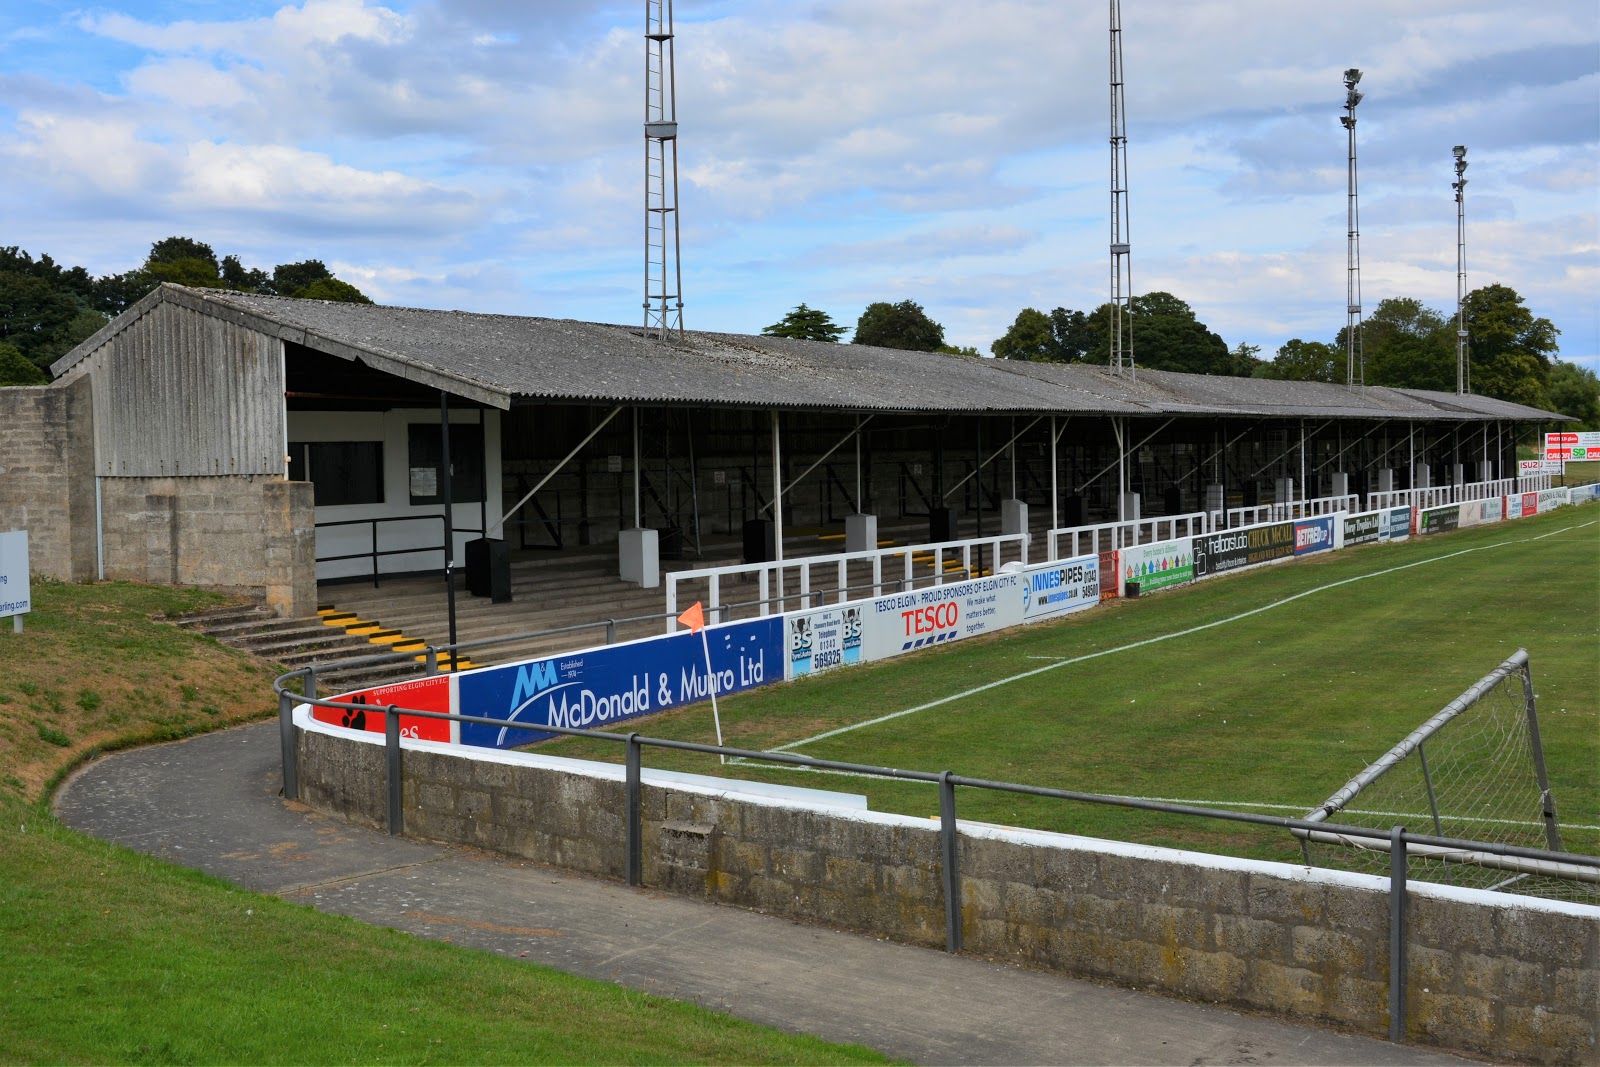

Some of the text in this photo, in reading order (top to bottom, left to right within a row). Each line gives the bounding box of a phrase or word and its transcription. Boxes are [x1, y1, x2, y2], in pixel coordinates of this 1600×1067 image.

[1247, 528, 1269, 549] CHUCK
[1296, 526, 1321, 547] BETFRED
[1032, 565, 1083, 592] INNESPIPES
[1083, 569, 1097, 584] 01343
[875, 598, 896, 613] TESCO
[897, 595, 917, 609] ELGIN
[921, 590, 942, 604] PROUD
[943, 585, 973, 600] SPONSORS
[974, 583, 982, 593] OF
[983, 580, 998, 592] ELGIN
[998, 577, 1009, 588] CITY
[1010, 575, 1017, 586] FC
[966, 594, 996, 607] We make what
[1038, 587, 1078, 606] www.innespipes.co.uk
[0, 600, 28, 612] arling.com
[966, 610, 982, 620] matters
[826, 620, 834, 628] Road
[901, 601, 959, 637] TESCO
[818, 629, 837, 640] Telephone
[842, 620, 862, 640] BS
[791, 630, 813, 652] BS
[820, 639, 836, 651] 01343
[560, 658, 584, 671] Established
[814, 649, 841, 669] 569325
[567, 670, 577, 679] 1974
[373, 676, 449, 697] SUPPORTING ELGIN CITY F.C.
[547, 648, 764, 729] McDonald & Munro Ltd
